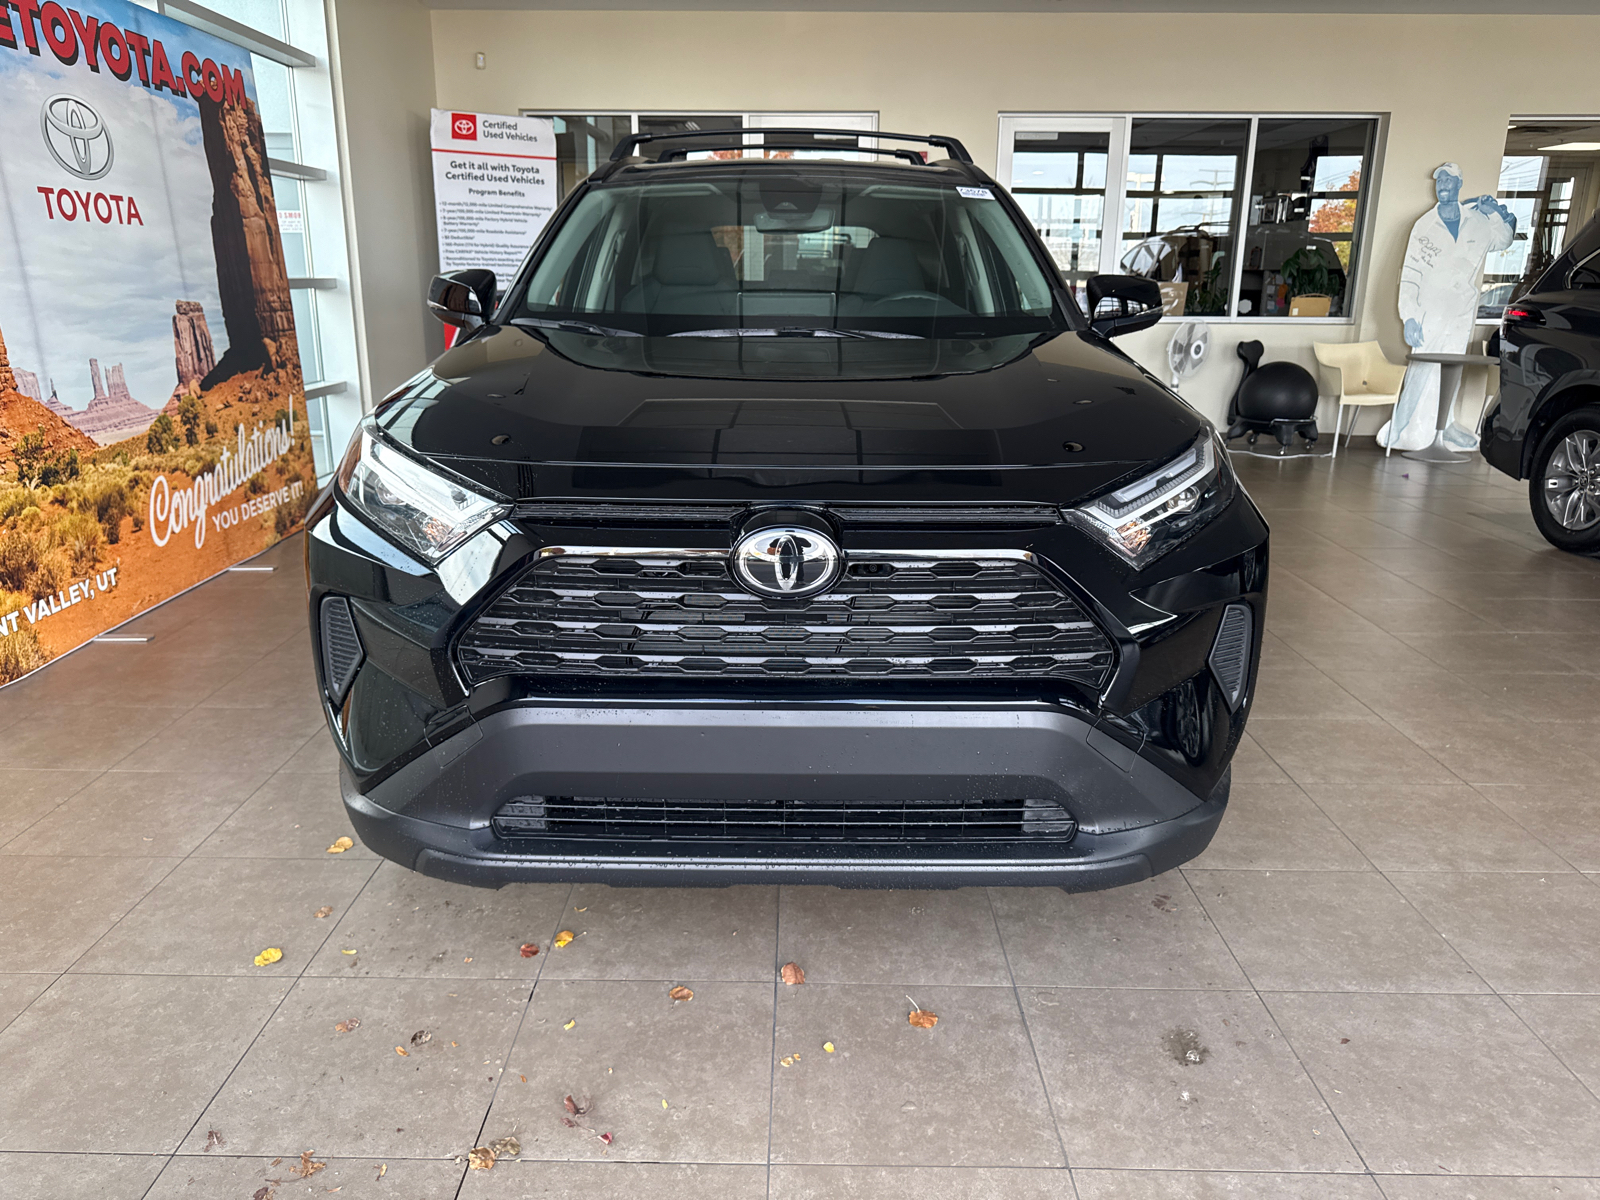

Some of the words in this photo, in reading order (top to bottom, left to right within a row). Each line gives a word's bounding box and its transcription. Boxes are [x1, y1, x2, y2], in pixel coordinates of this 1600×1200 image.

[483, 120, 517, 130] Certified
[483, 130, 503, 139] Used
[506, 133, 537, 142] Vehicles
[450, 161, 467, 170] Get
[468, 162, 475, 170] it
[477, 162, 488, 171] all
[491, 164, 509, 172] with
[512, 165, 540, 174] Toyota
[445, 172, 484, 181] Certified
[487, 174, 508, 183] Used
[511, 176, 545, 185] Vehicles
[469, 188, 497, 197] Program
[37, 186, 144, 227] TOYOTA
[150, 394, 295, 549] Congratulations!
[212, 507, 239, 532] YOU
[241, 484, 290, 521] DESERVE
[291, 480, 304, 500] IT!
[23, 578, 95, 625] VALLEY,
[96, 567, 117, 591] UT
